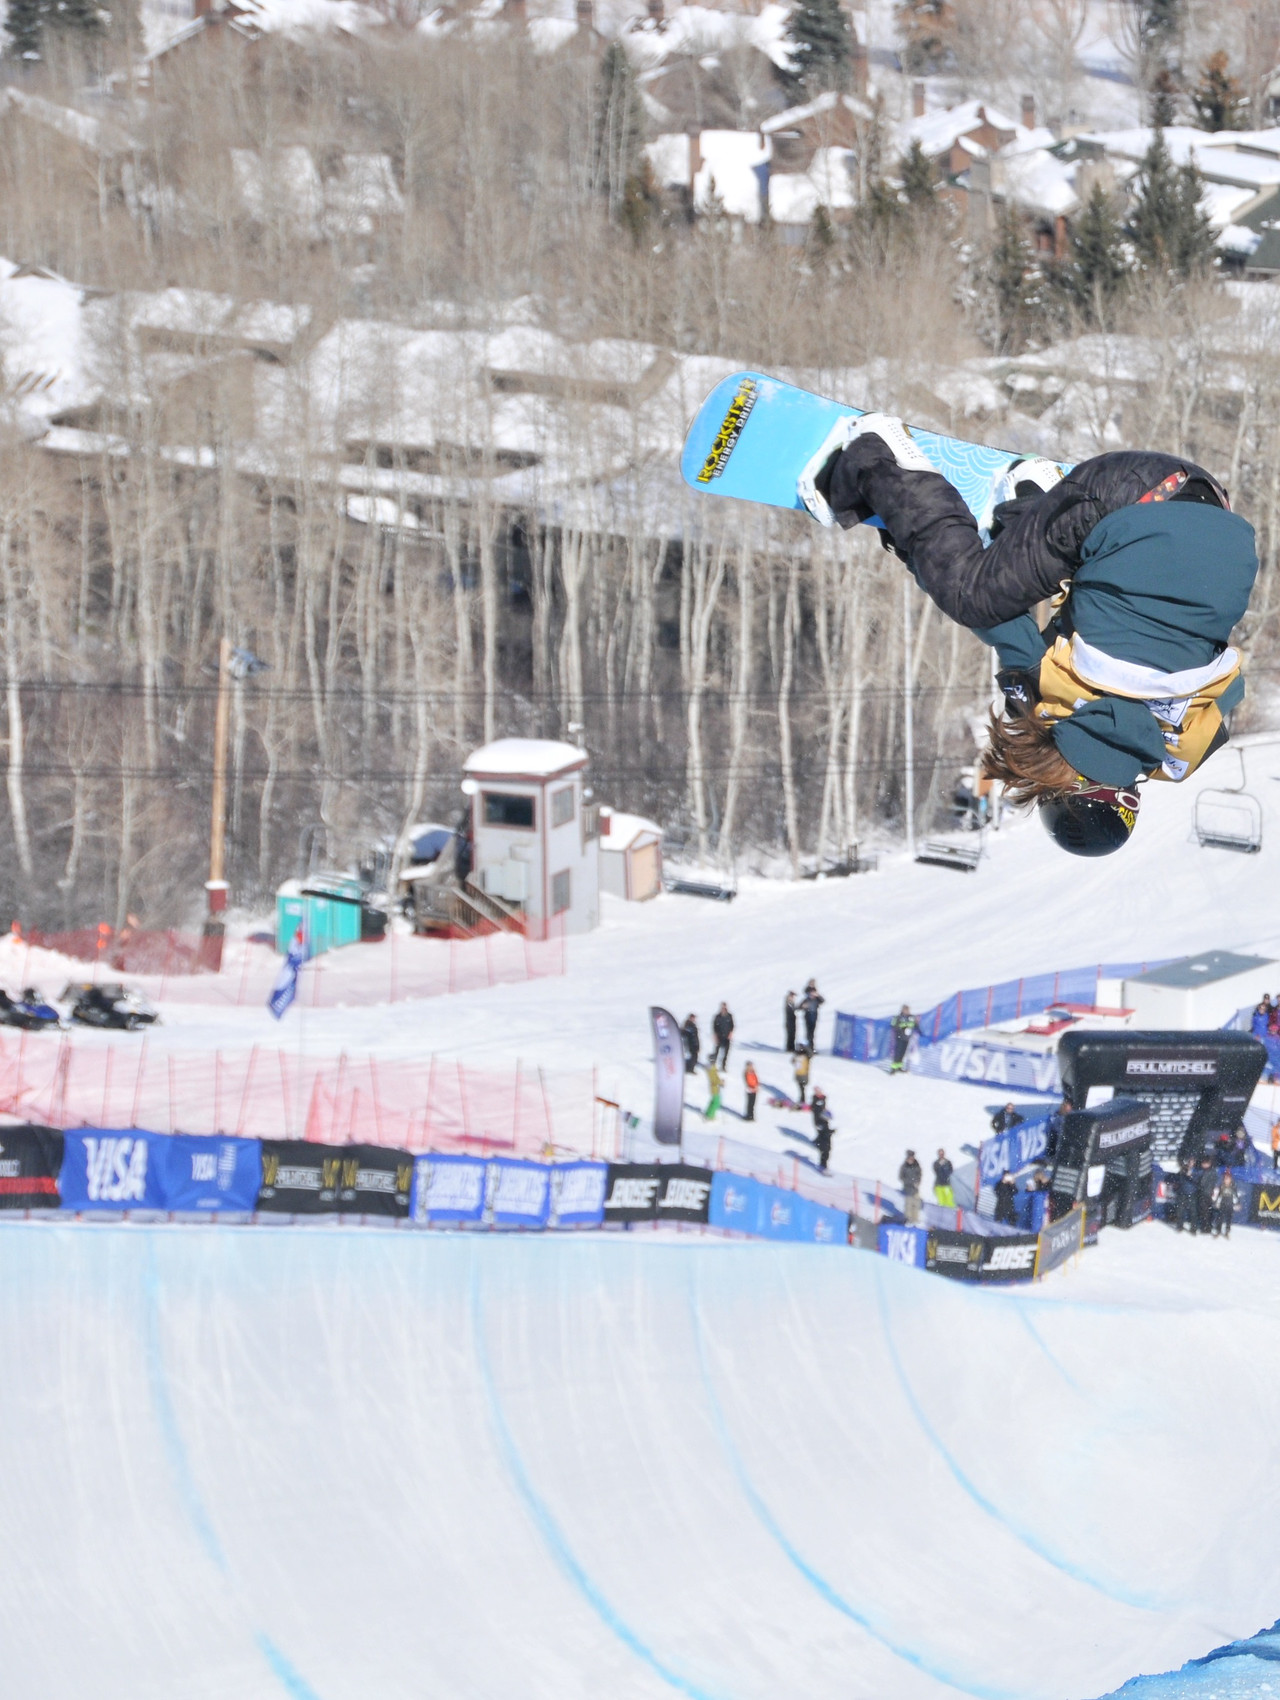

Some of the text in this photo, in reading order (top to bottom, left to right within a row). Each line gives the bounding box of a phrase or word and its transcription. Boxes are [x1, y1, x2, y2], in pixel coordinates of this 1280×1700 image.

[712, 391, 758, 477] ENERGY DRINK
[939, 1043, 1008, 1085] VISA
[1017, 1122, 1046, 1162] VIS
[82, 1137, 148, 1201] VISA
[886, 1229, 917, 1267] VISA
[983, 1244, 1039, 1271] BOSE
